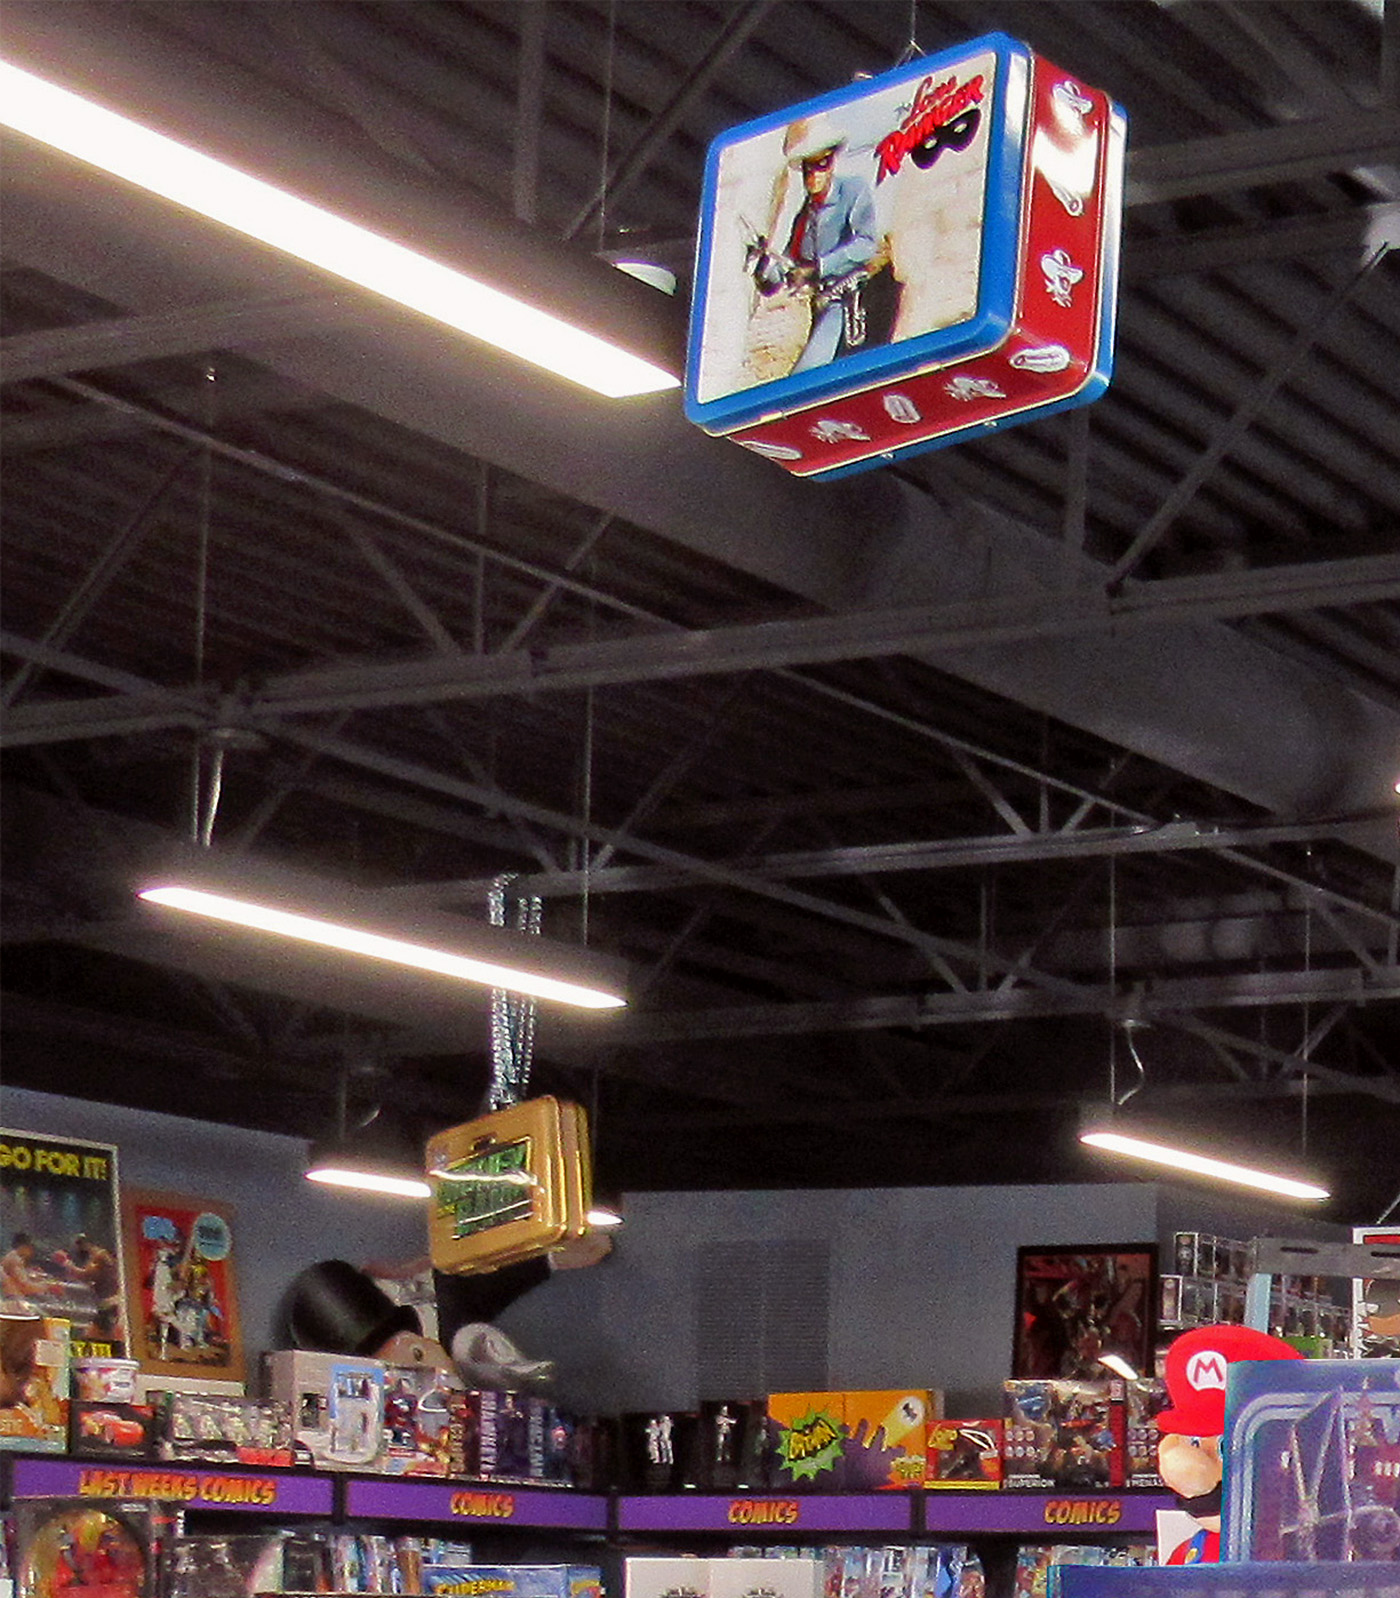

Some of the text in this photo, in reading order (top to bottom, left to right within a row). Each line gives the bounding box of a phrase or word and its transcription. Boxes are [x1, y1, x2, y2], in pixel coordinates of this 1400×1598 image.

[35, 1149, 80, 1176] FOR
[1193, 1357, 1223, 1383] M
[79, 1470, 278, 1505] LAST WEEKS COMICS
[451, 1491, 515, 1518] COMICS
[728, 1500, 798, 1525] COMICS
[1045, 1501, 1122, 1525] COMICS
